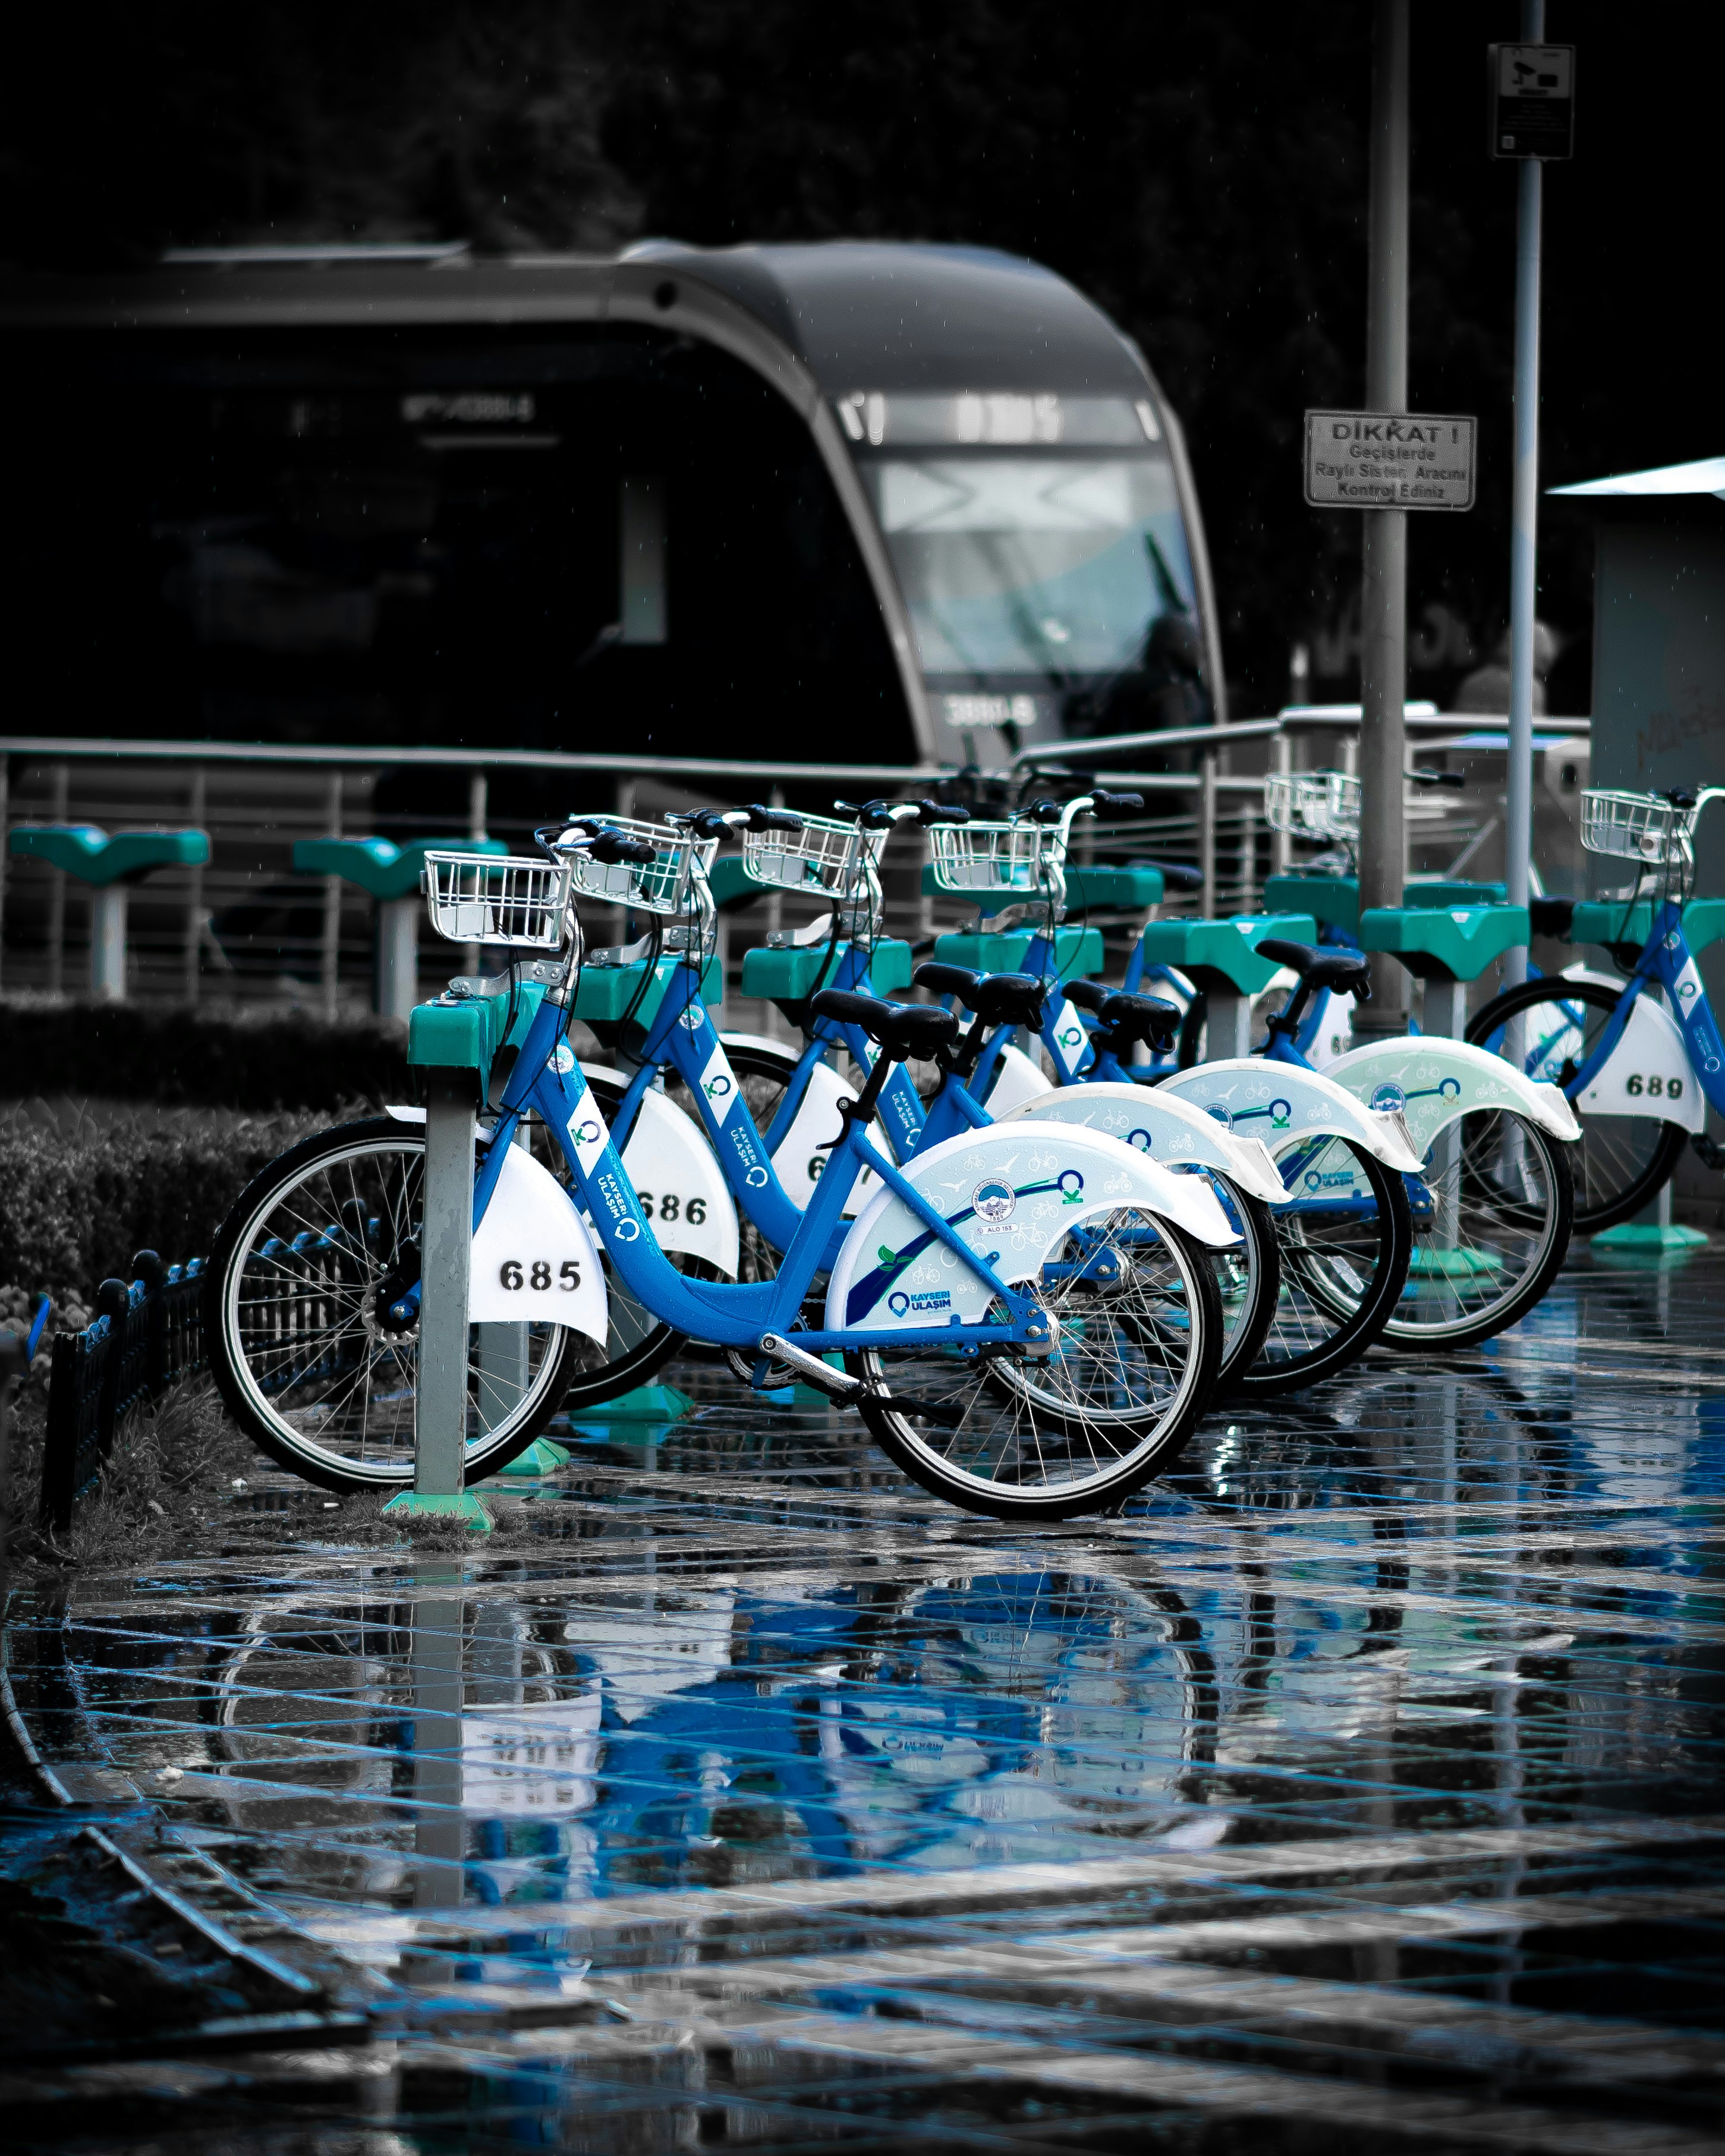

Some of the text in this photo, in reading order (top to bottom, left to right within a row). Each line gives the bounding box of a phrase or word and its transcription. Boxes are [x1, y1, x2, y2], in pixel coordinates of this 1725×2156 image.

[1331, 420, 1441, 443] DİKKAT
[1626, 1072, 1683, 1100] 689
[597, 1176, 621, 1219] ULAŞIM
[606, 1173, 629, 1215] KAYSERİ
[637, 1191, 707, 1226] 686
[499, 1260, 581, 1291] 685
[911, 1290, 950, 1302] KAYSERİ
[911, 1299, 952, 1311] ULAŞIM
